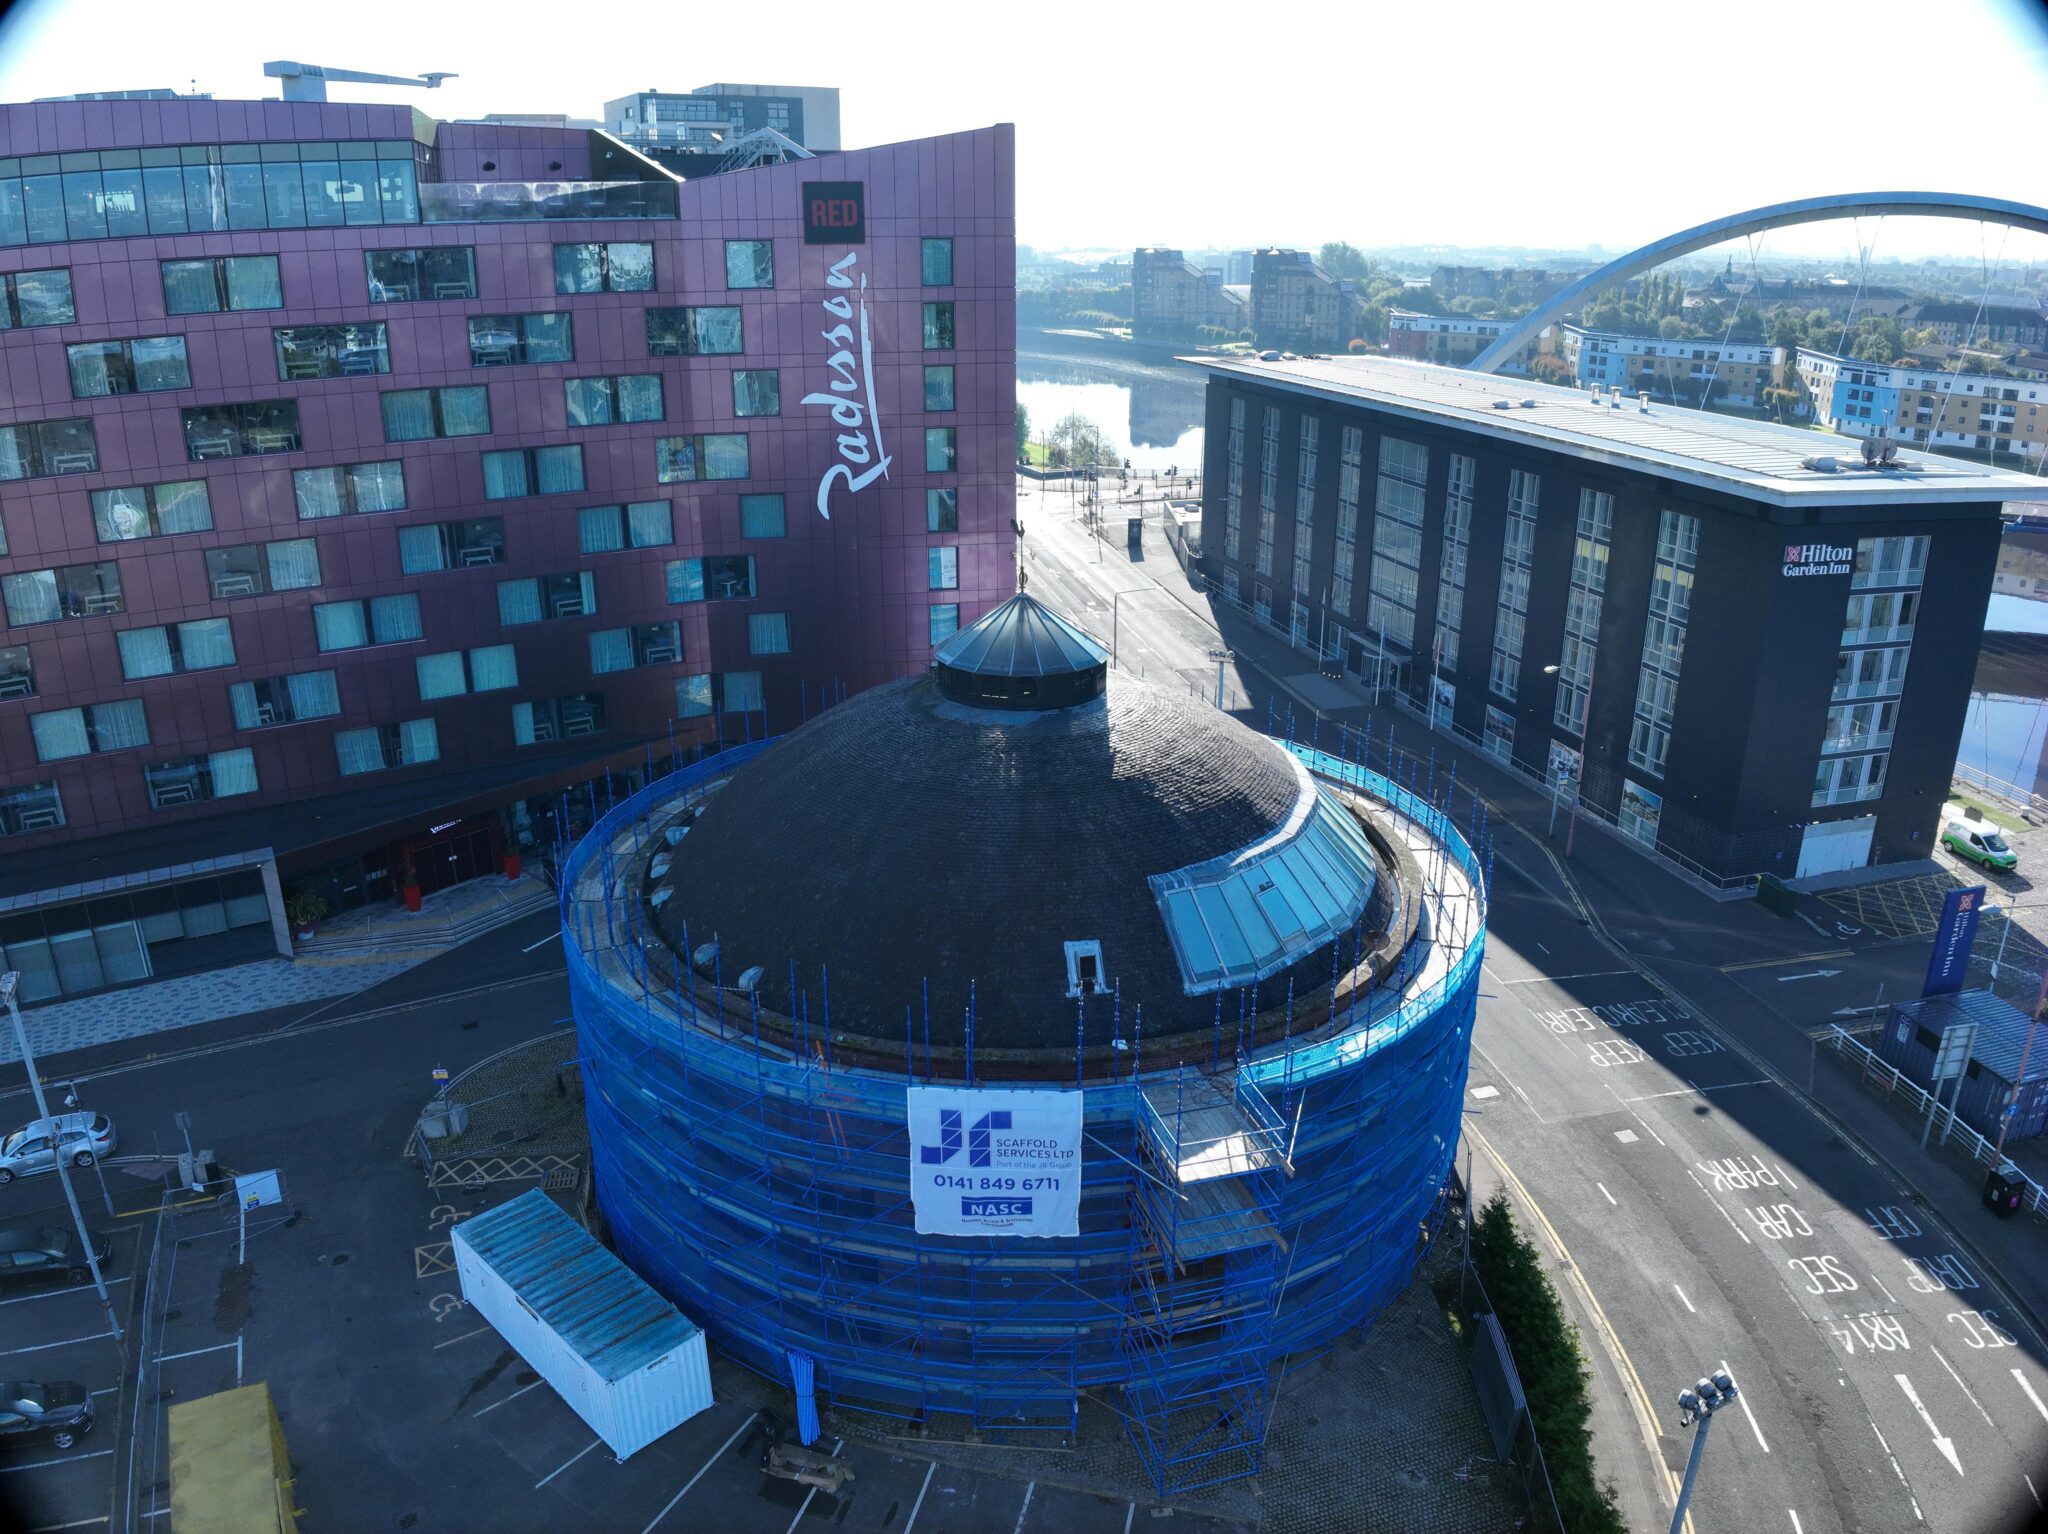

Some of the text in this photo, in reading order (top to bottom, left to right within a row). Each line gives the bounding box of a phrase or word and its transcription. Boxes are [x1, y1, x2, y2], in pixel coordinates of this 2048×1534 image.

[811, 200, 858, 226] RED
[800, 252, 892, 520] Radisson
[1800, 544, 1853, 563] Hilton
[1783, 562, 1850, 577] Garden Inn
[1942, 912, 1964, 977] Garden Inn
[1586, 1038, 1654, 1067] KEEP
[1664, 1031, 1726, 1057] KEEP
[996, 1138, 1058, 1148] SCAFFOLD
[996, 1149, 1074, 1159] SERVICES LTD
[1050, 1161, 1072, 1170] Group
[1697, 1155, 1779, 1191] PARK
[934, 1175, 1060, 1191] 0141 849 6711
[971, 1202, 1022, 1215] NASC
[1745, 1204, 1813, 1239] CAR
[1865, 1206, 1922, 1240] OFF
[1788, 1256, 1858, 1294] SEC
[1903, 1254, 1979, 1293] DROP
[1823, 1311, 1911, 1354] A814
[1947, 1309, 2018, 1348] SEC
